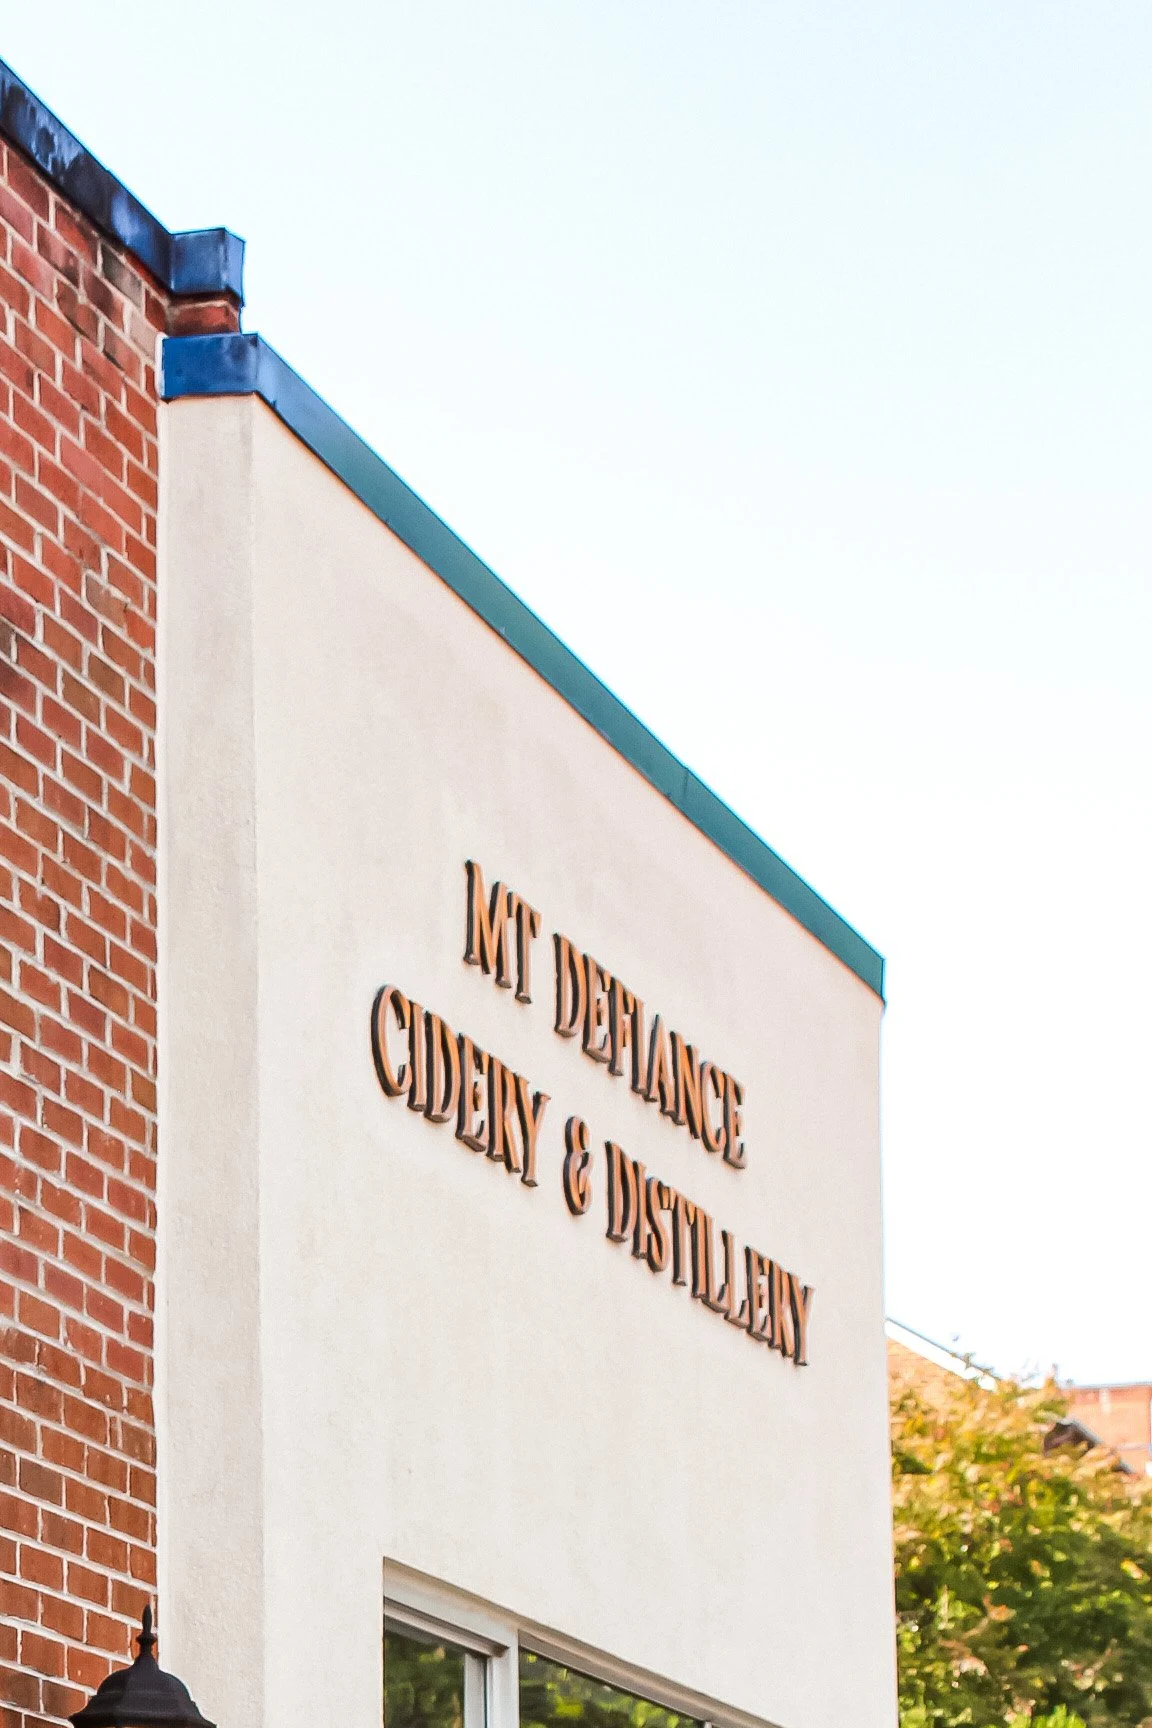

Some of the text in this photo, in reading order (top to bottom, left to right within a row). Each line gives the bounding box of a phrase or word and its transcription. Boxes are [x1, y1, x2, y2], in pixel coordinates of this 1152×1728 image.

[371, 984, 815, 1367] CIDERY & DISTILLERY
[464, 859, 746, 1170] MT DEFIANCE
